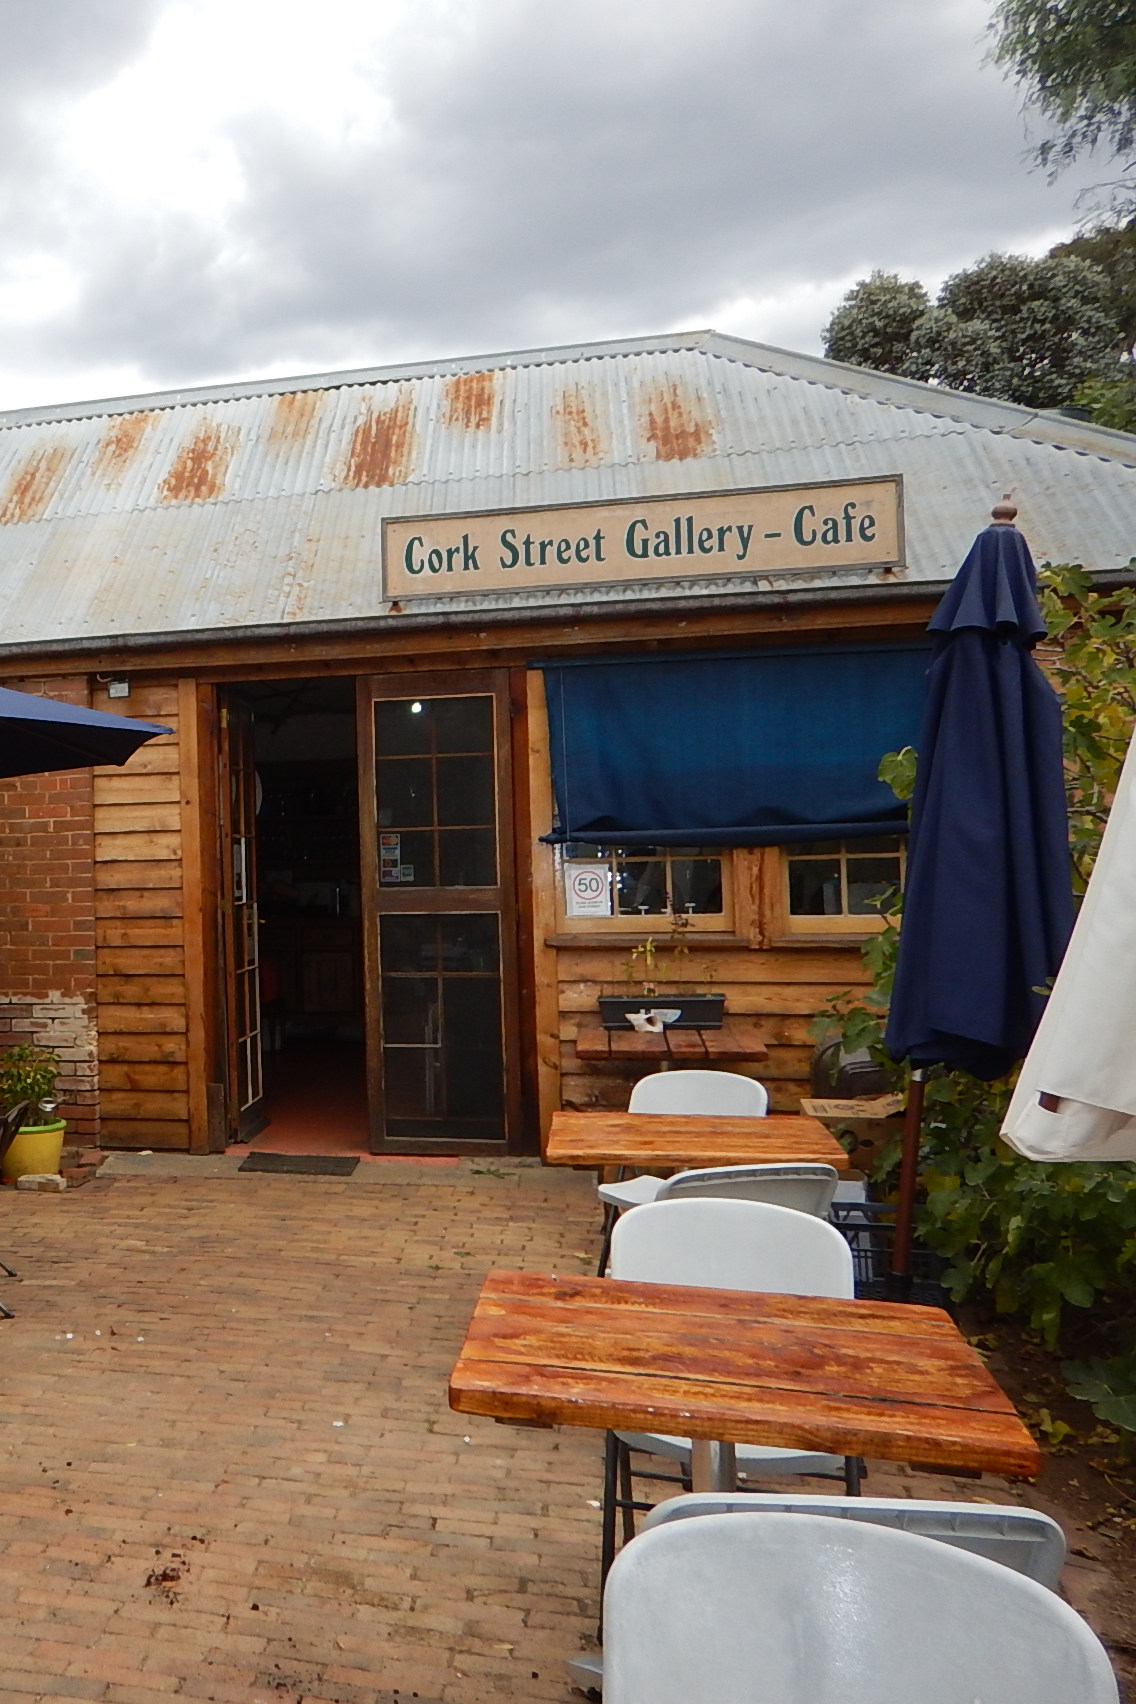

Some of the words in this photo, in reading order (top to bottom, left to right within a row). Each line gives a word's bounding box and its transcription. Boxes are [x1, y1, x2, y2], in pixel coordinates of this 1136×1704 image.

[403, 533, 480, 575] Cork
[499, 528, 606, 569] Street
[625, 515, 754, 561] Gallery
[793, 501, 876, 547] Cafe
[577, 877, 600, 893] 50
